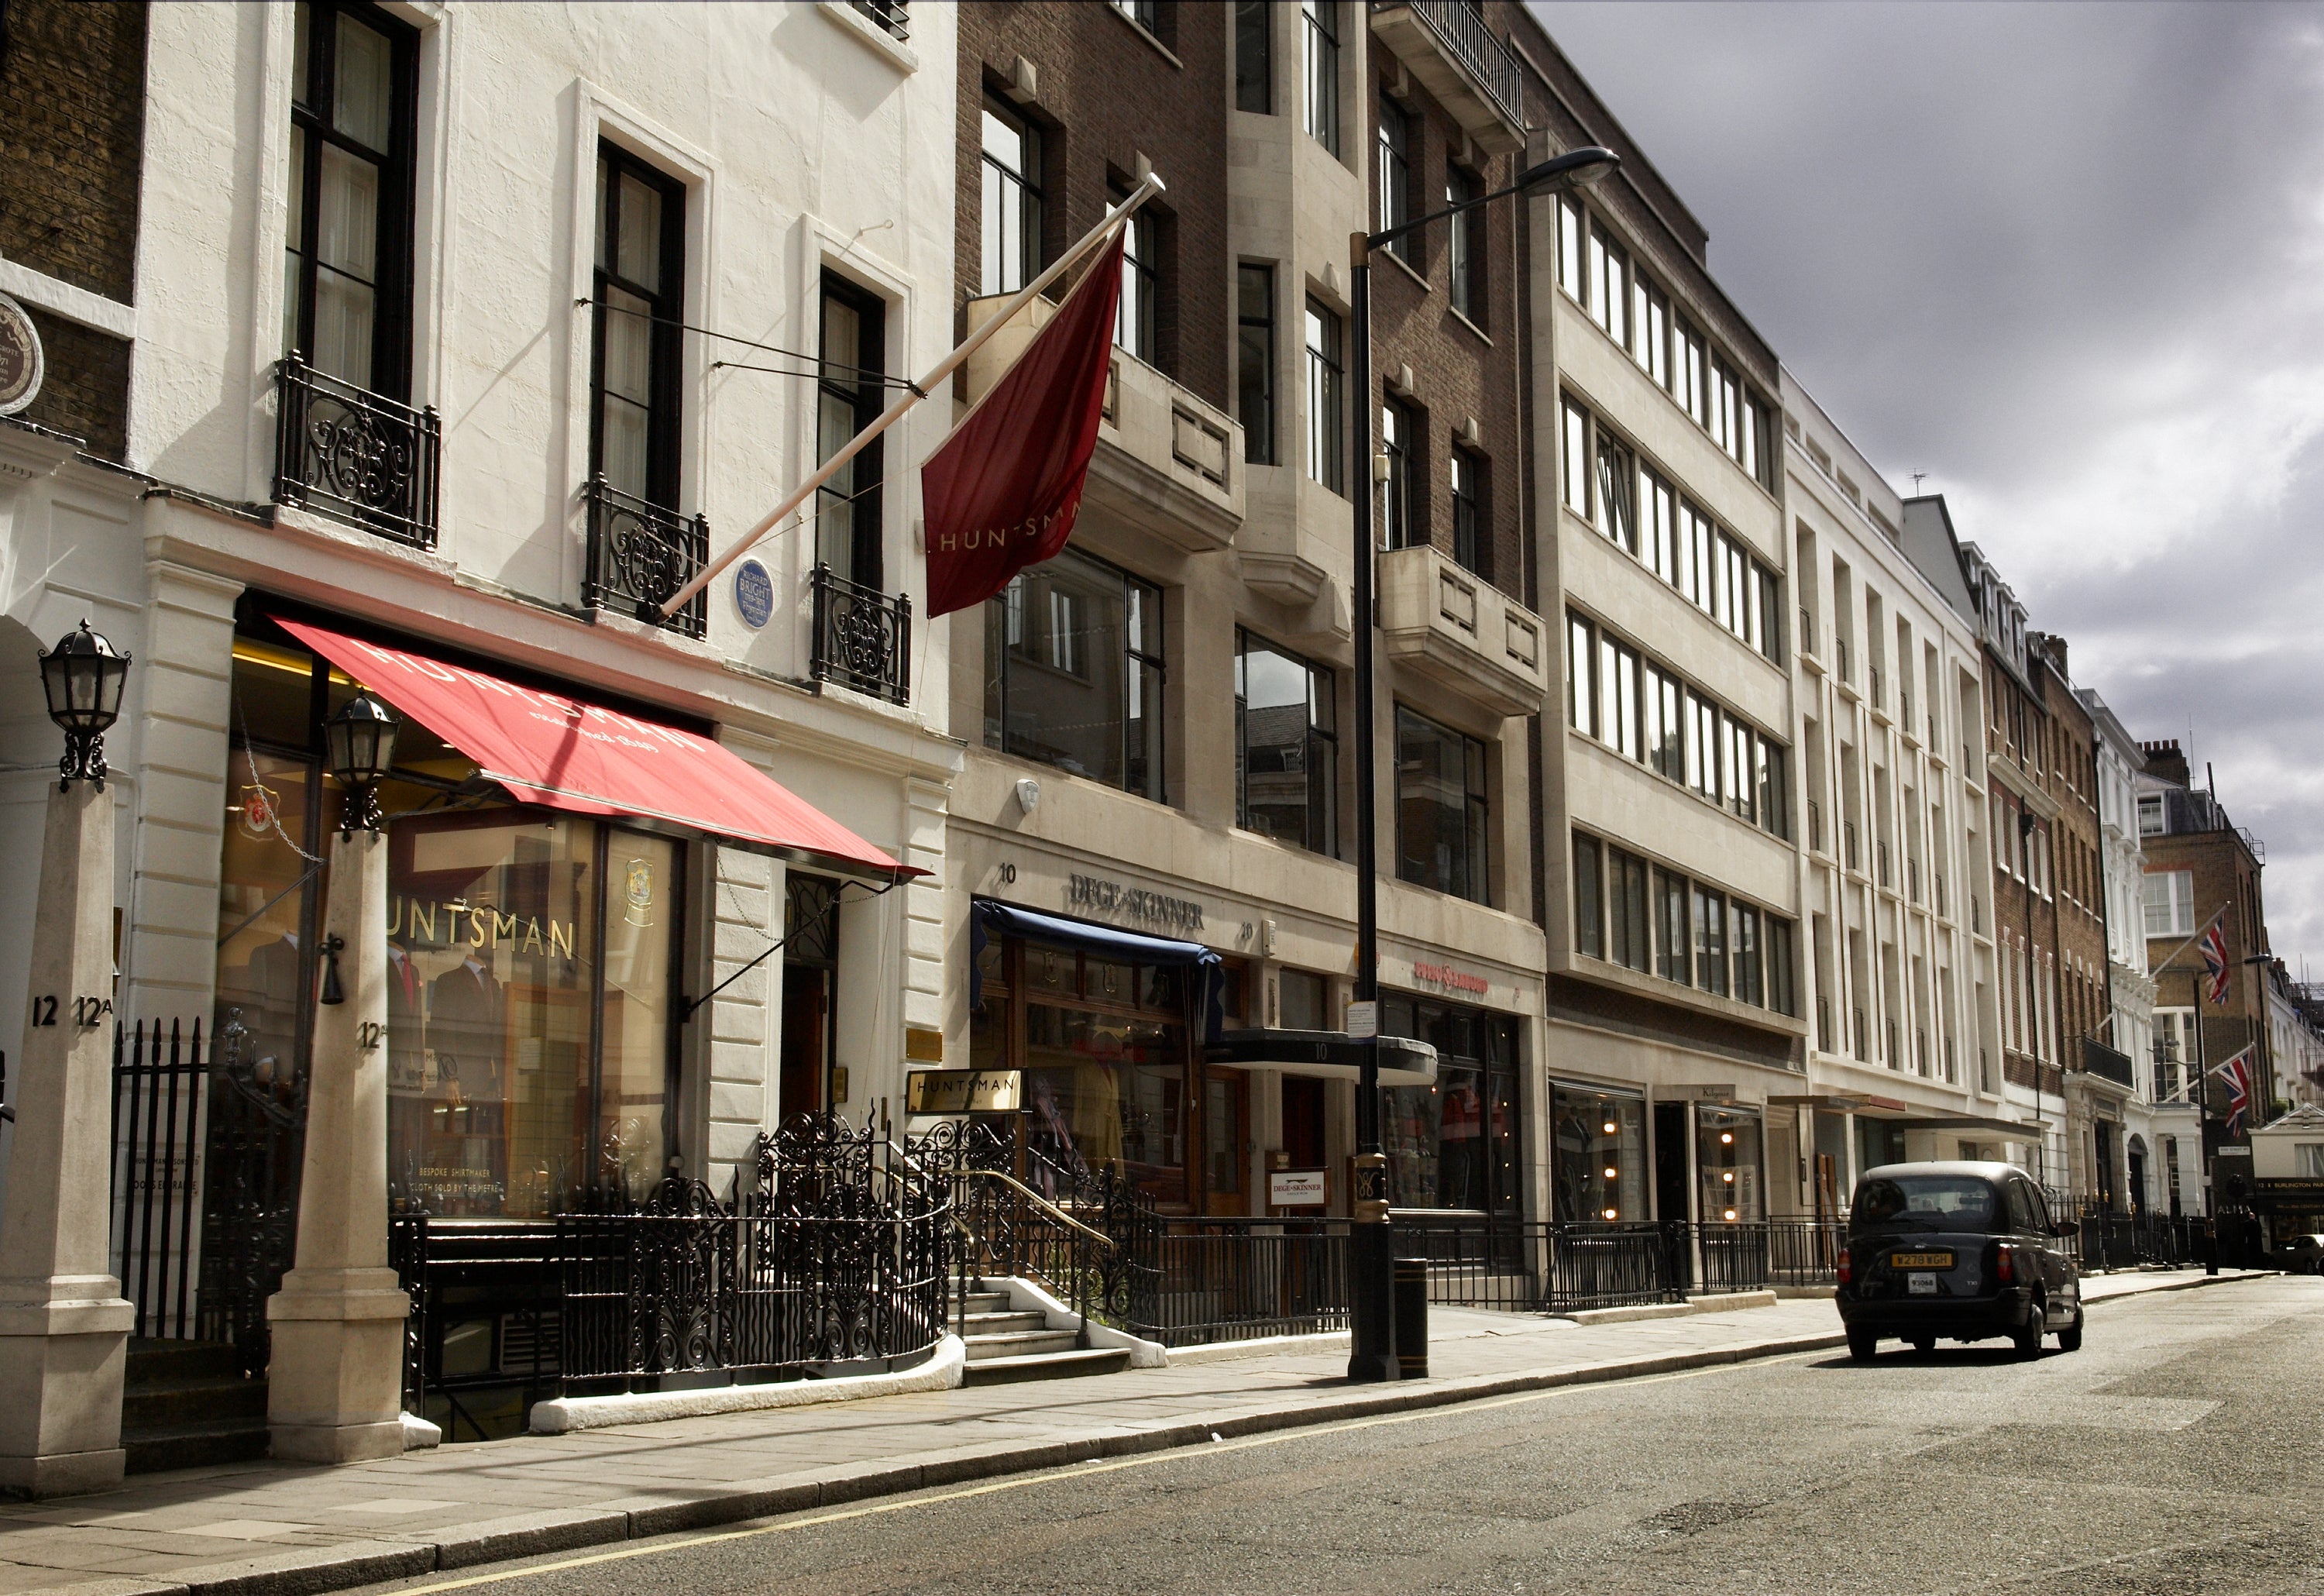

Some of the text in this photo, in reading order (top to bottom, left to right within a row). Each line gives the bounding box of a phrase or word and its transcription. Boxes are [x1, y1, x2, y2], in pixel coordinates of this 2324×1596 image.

[743, 570, 768, 586] RICHARD
[740, 578, 771, 600] BRIGHT
[350, 639, 706, 752] HUNTSMAN
[999, 863, 1016, 884] 10
[1070, 872, 1122, 912] DEGE
[1129, 887, 1205, 930] SKINNER
[386, 895, 573, 960] UNTSMAN
[1241, 920, 1253, 940] 10
[33, 996, 58, 1027] 12
[78, 996, 113, 1027] 12A
[1315, 1042, 1327, 1060] 10
[917, 1078, 1014, 1092] HUNTSMAN
[1703, 1087, 1729, 1099] Kilgour
[419, 1168, 490, 1178] BESPOKE SHIRTMAKER
[158, 1181, 197, 1190] ERAE
[411, 1183, 432, 1192] CLOTH
[454, 1184, 462, 1192] BY
[465, 1184, 476, 1192] THE
[478, 1185, 498, 1193] METRE
[1898, 1254, 1948, 1264] W278 WGH
